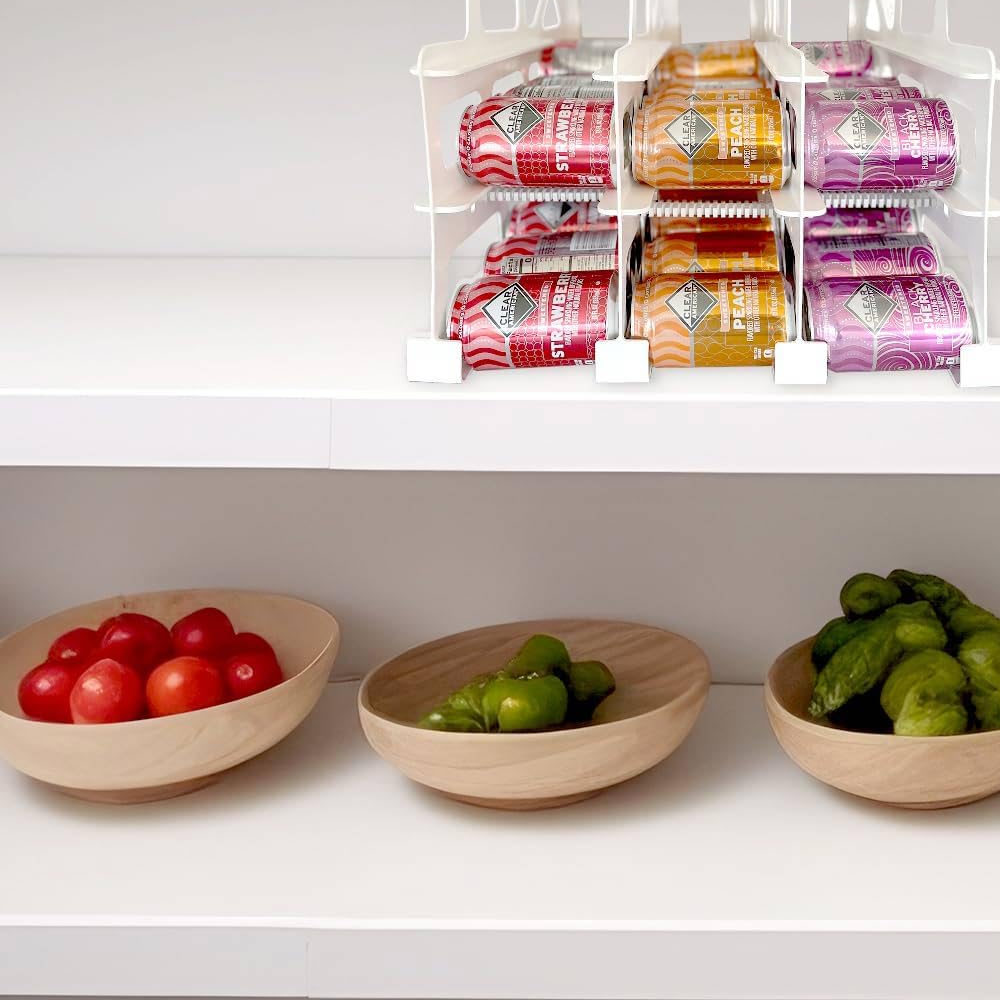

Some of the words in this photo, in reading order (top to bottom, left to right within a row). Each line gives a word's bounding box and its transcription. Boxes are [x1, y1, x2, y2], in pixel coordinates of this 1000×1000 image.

[506, 105, 519, 134] CLEAR
[515, 104, 525, 134] AMERICAN
[730, 108, 742, 157] PEACH
[852, 116, 861, 149] CLEAR
[859, 113, 867, 149] AMERICAN
[898, 113, 911, 150] BLACK
[905, 108, 921, 158] CHERRY
[500, 291, 512, 326] CLEAR
[509, 289, 518, 326] AMERICAN
[732, 279, 745, 329] PEACH
[861, 290, 872, 322] CLEAR
[868, 287, 879, 322] AMERICAN
[906, 287, 924, 324] BLACK
[913, 282, 935, 333] CHERRY
